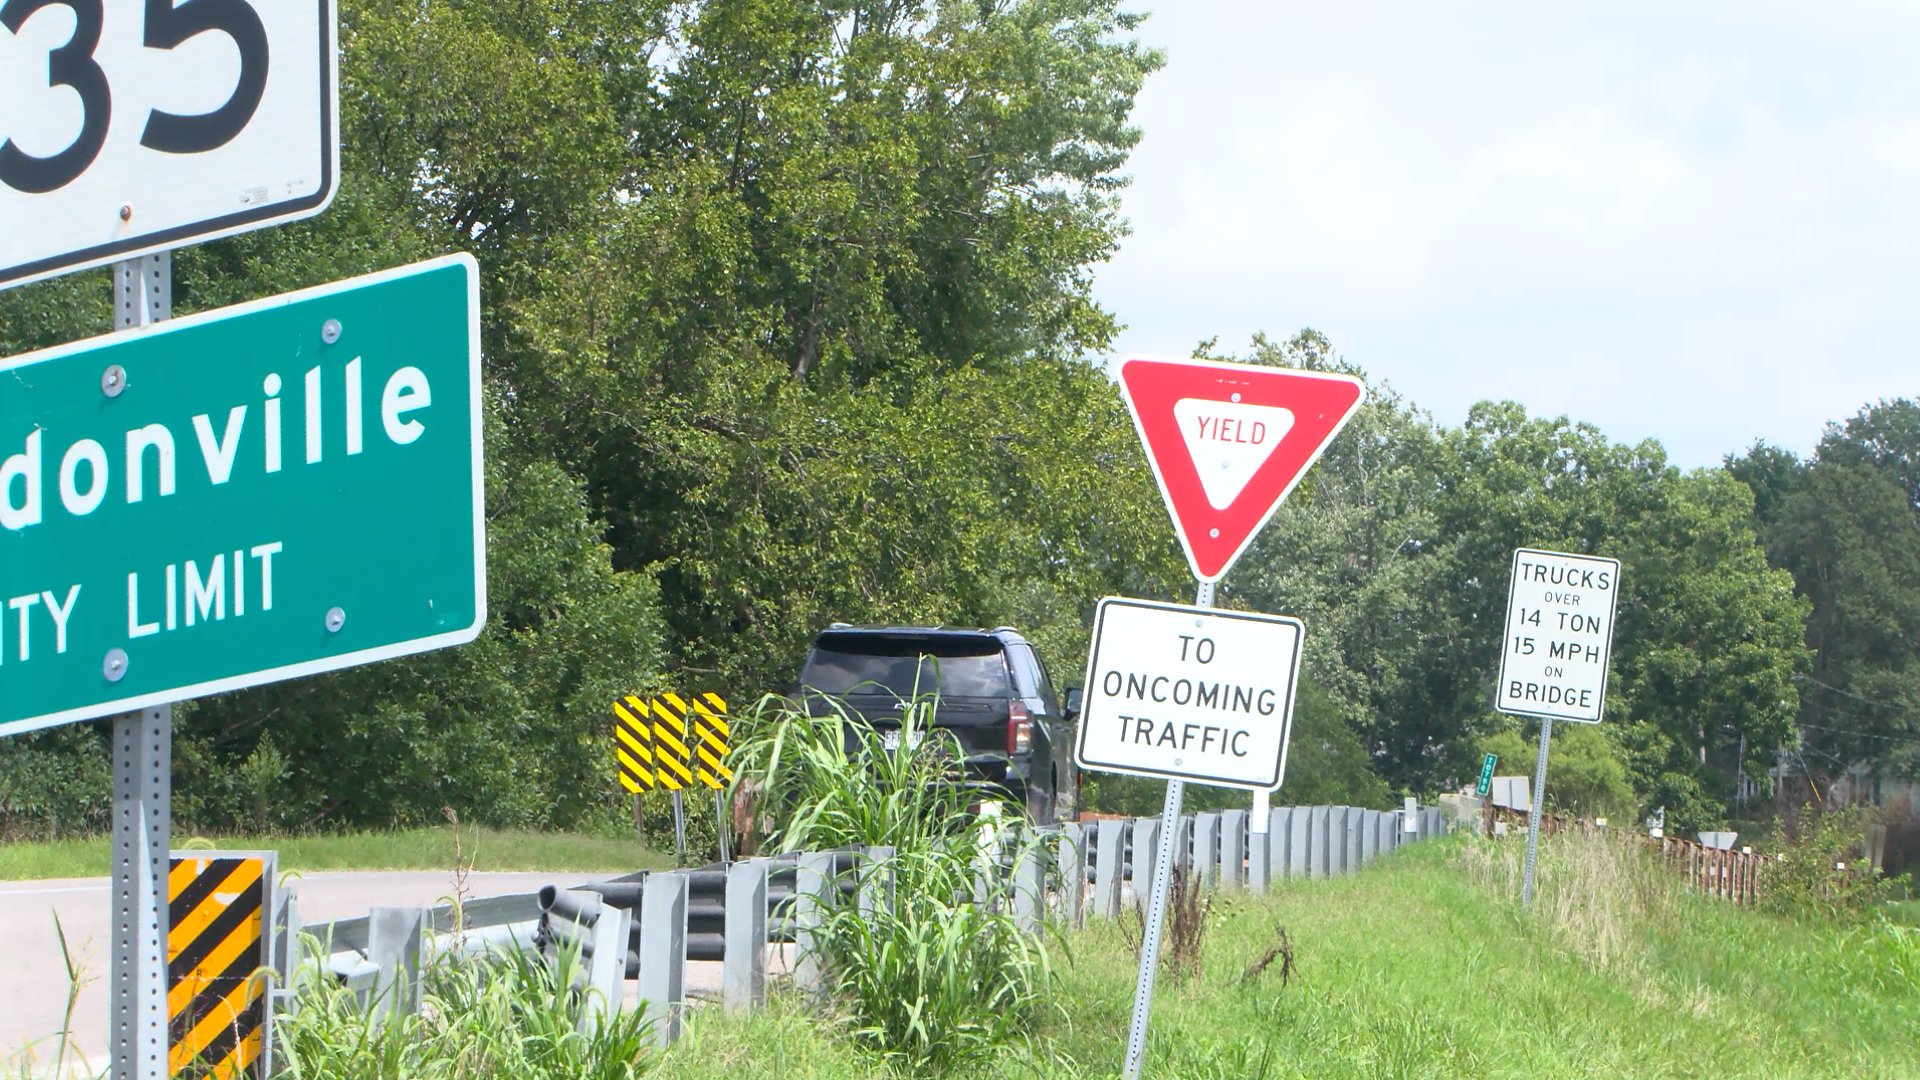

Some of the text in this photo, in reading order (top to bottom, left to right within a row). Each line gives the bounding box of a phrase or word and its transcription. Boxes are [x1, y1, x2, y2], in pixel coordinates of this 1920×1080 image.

[0, 0, 269, 193] 35
[0, 356, 432, 530] donville
[1197, 415, 1266, 445] YIELD
[128, 541, 283, 639] LIMIT
[1522, 563, 1610, 590] TRUCKS
[1544, 591, 1580, 606] OVER
[1520, 607, 1600, 634] 14 TON
[1178, 635, 1215, 664] TO
[1514, 636, 1599, 663] 15 MPH
[1544, 665, 1563, 678] ON
[1103, 670, 1276, 716] ONCOMING
[1509, 680, 1592, 708] BRIDGE
[1118, 715, 1250, 757] TRAFFIC
